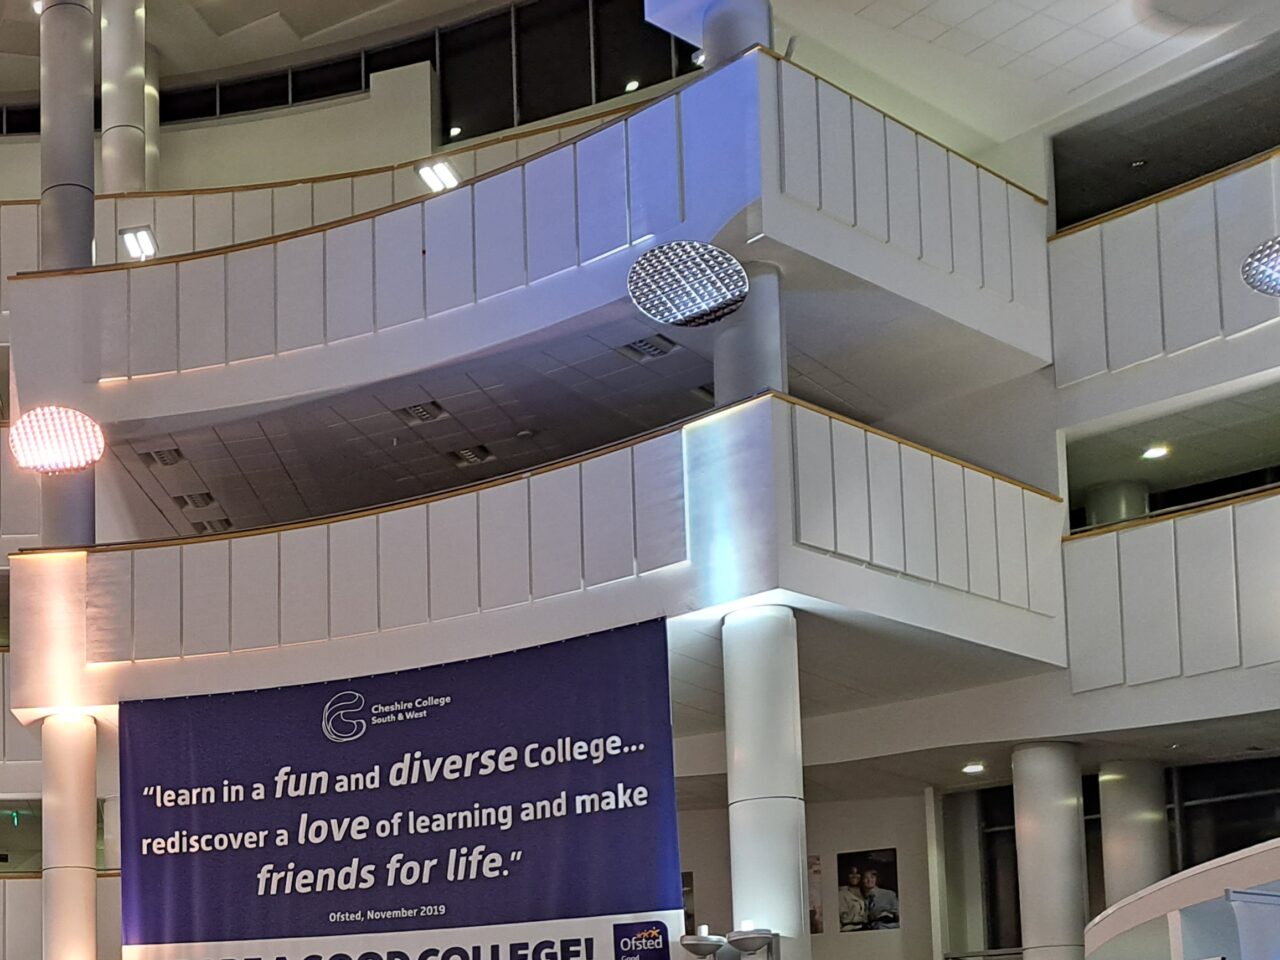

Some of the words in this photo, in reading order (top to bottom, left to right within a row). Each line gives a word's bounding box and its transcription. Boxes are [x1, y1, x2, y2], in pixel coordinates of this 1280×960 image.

[371, 702, 413, 713] Cheshire
[415, 696, 451, 707] College
[371, 714, 395, 724] South
[405, 710, 427, 720] West
[223, 780, 244, 803] in
[251, 782, 265, 800] a
[274, 766, 329, 798] fun
[334, 765, 380, 793] and
[388, 744, 518, 787] diverse
[141, 829, 269, 855] rediscover
[275, 828, 289, 846] a
[297, 813, 370, 845] love
[375, 812, 403, 838] of
[408, 802, 513, 834] learning
[520, 791, 567, 822] and
[575, 783, 649, 814] make
[257, 857, 376, 896] friends
[386, 853, 438, 887] for
[328, 910, 364, 923] Ofsted,
[367, 907, 418, 921] November
[420, 904, 446, 917] 2019
[620, 935, 663, 951] Ofsted
